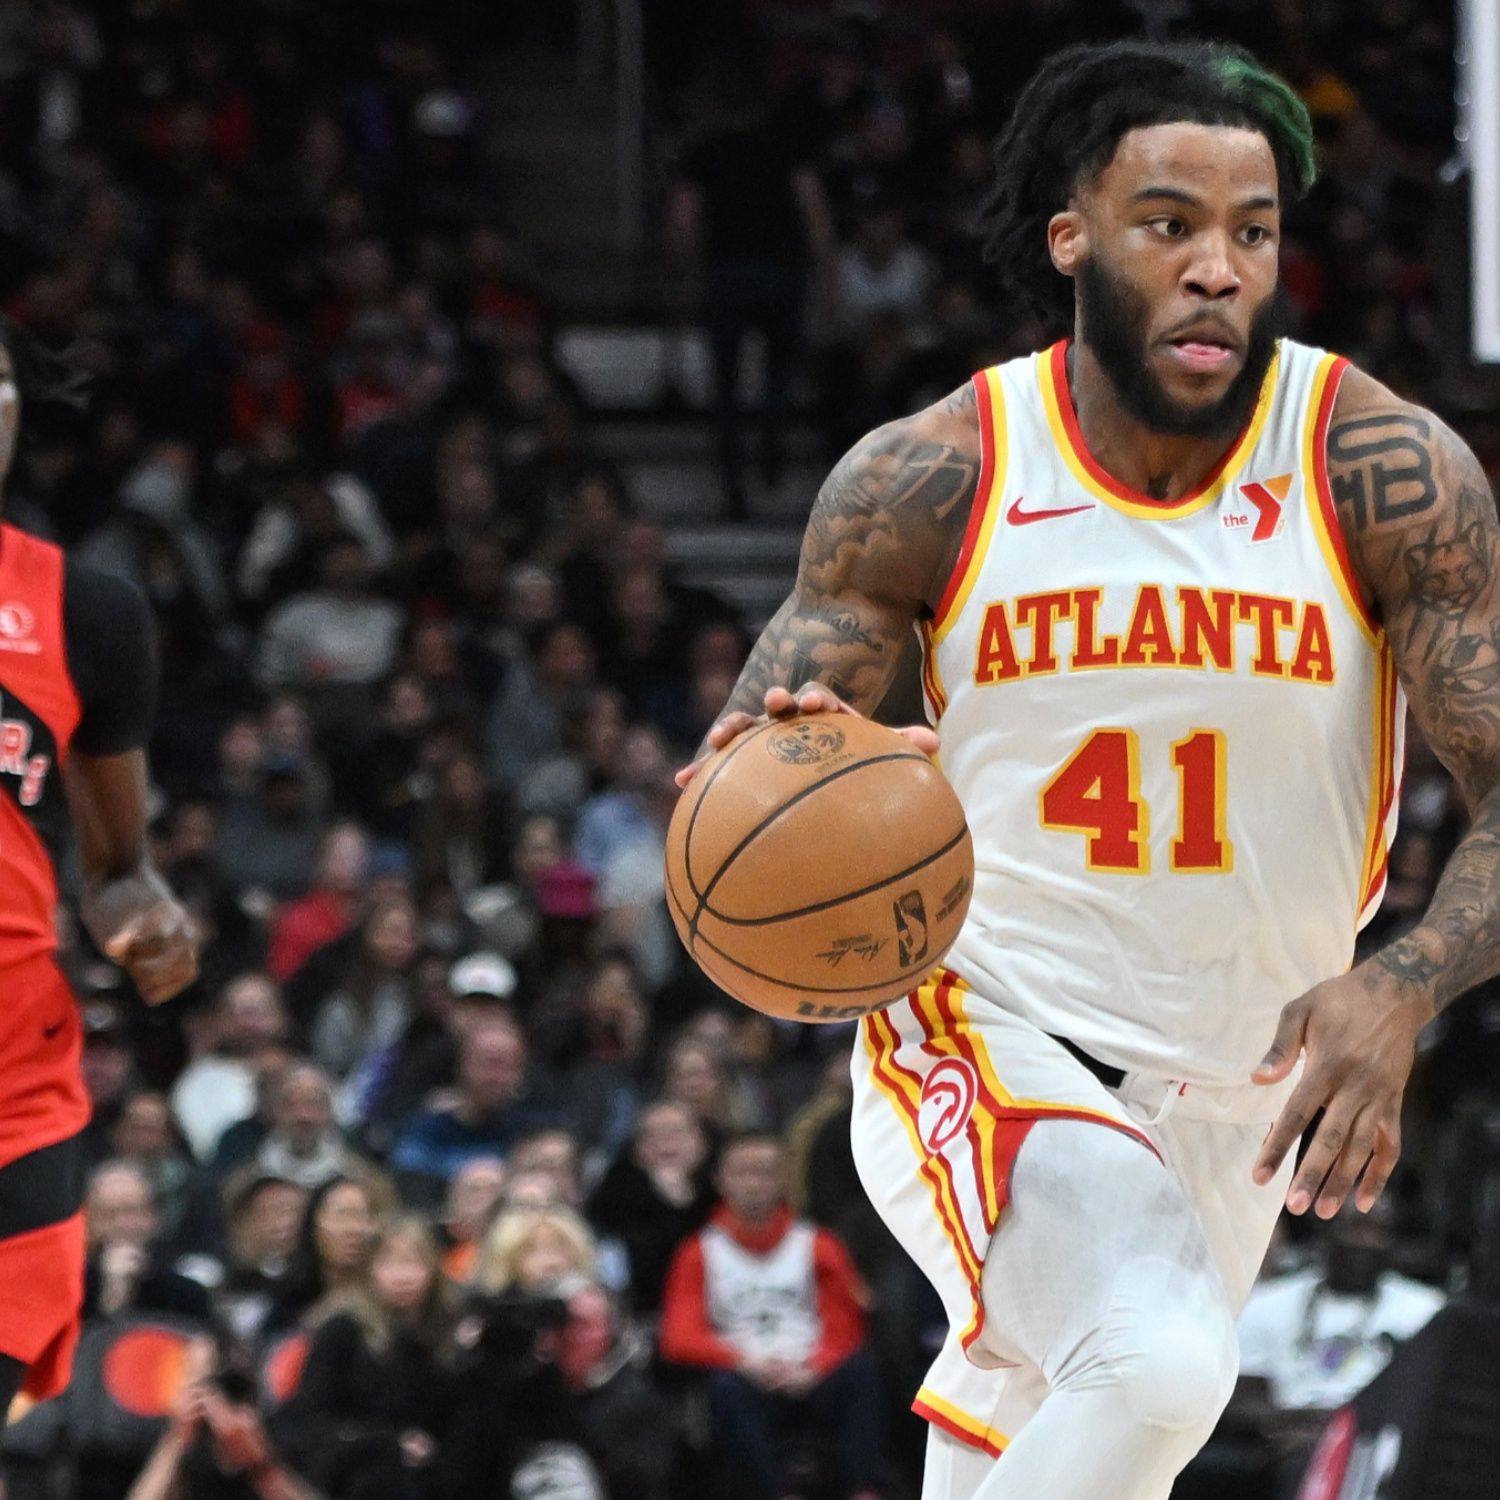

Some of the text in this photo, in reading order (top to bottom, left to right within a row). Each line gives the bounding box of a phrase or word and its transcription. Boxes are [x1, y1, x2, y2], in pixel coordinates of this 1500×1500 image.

[1223, 513, 1249, 528] the
[973, 584, 1337, 688] ATLANTA
[1038, 726, 1233, 875] 41
